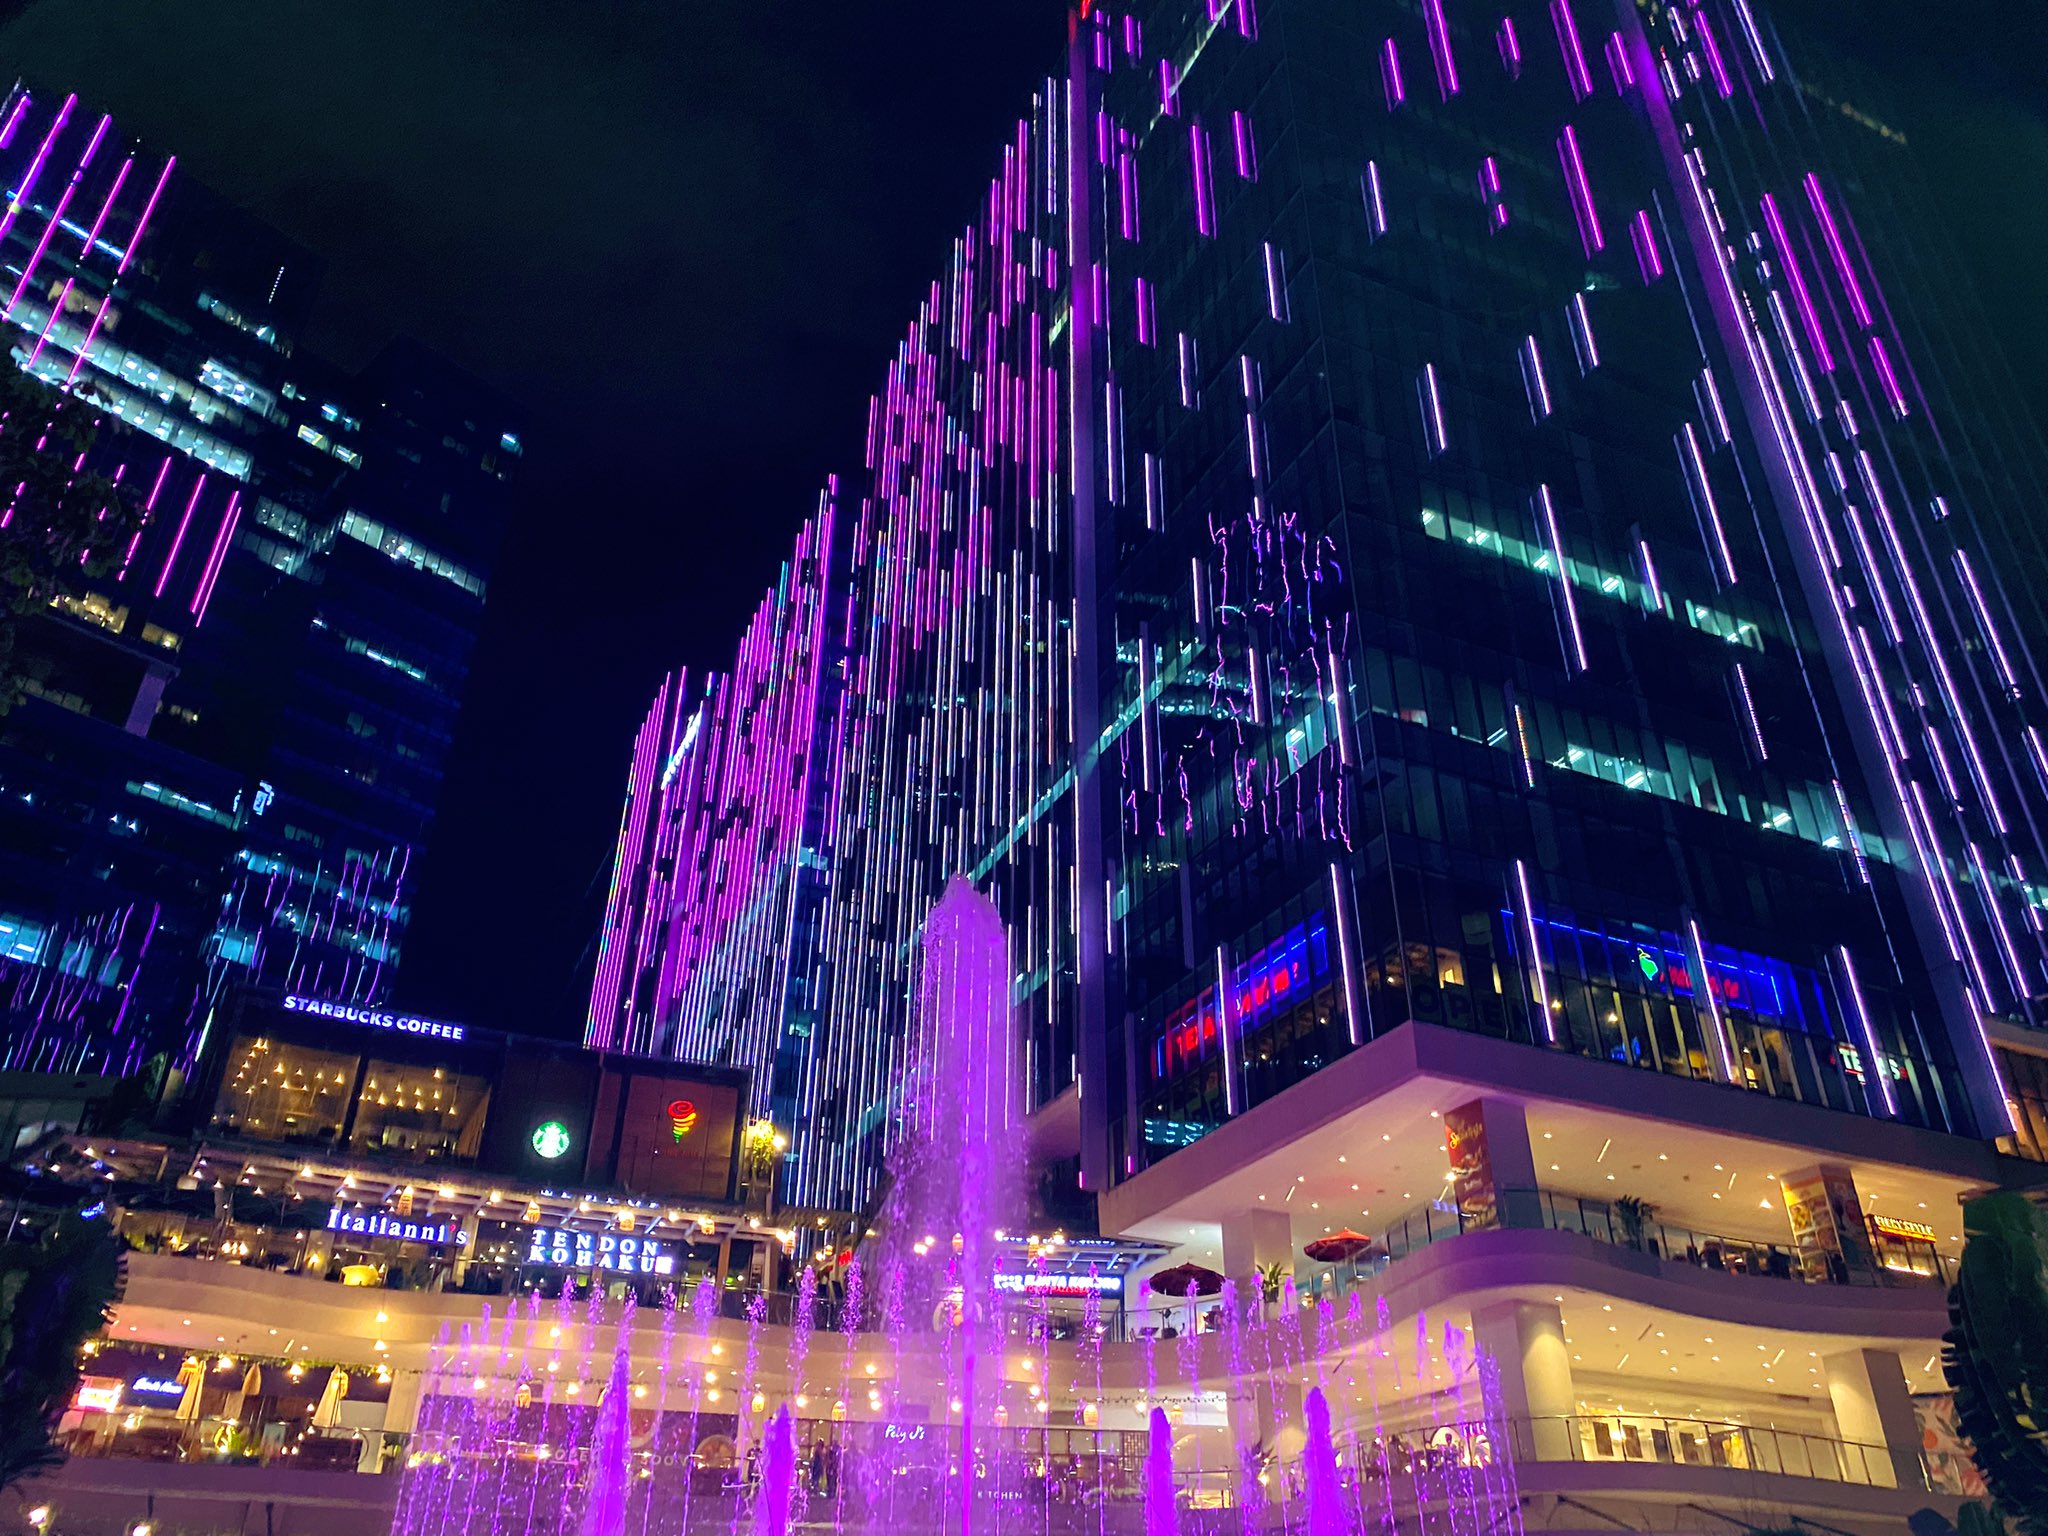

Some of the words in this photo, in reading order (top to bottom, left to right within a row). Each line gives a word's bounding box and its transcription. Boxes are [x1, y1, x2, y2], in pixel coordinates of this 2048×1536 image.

[284, 995, 393, 1028] STARBUCKS
[396, 1018, 463, 1040] COFFEE
[327, 1208, 468, 1245] Italianni's
[532, 1229, 659, 1257] TENDON
[529, 1245, 656, 1273] KOHAKU
[977, 1490, 1023, 1500] KTCHEN
